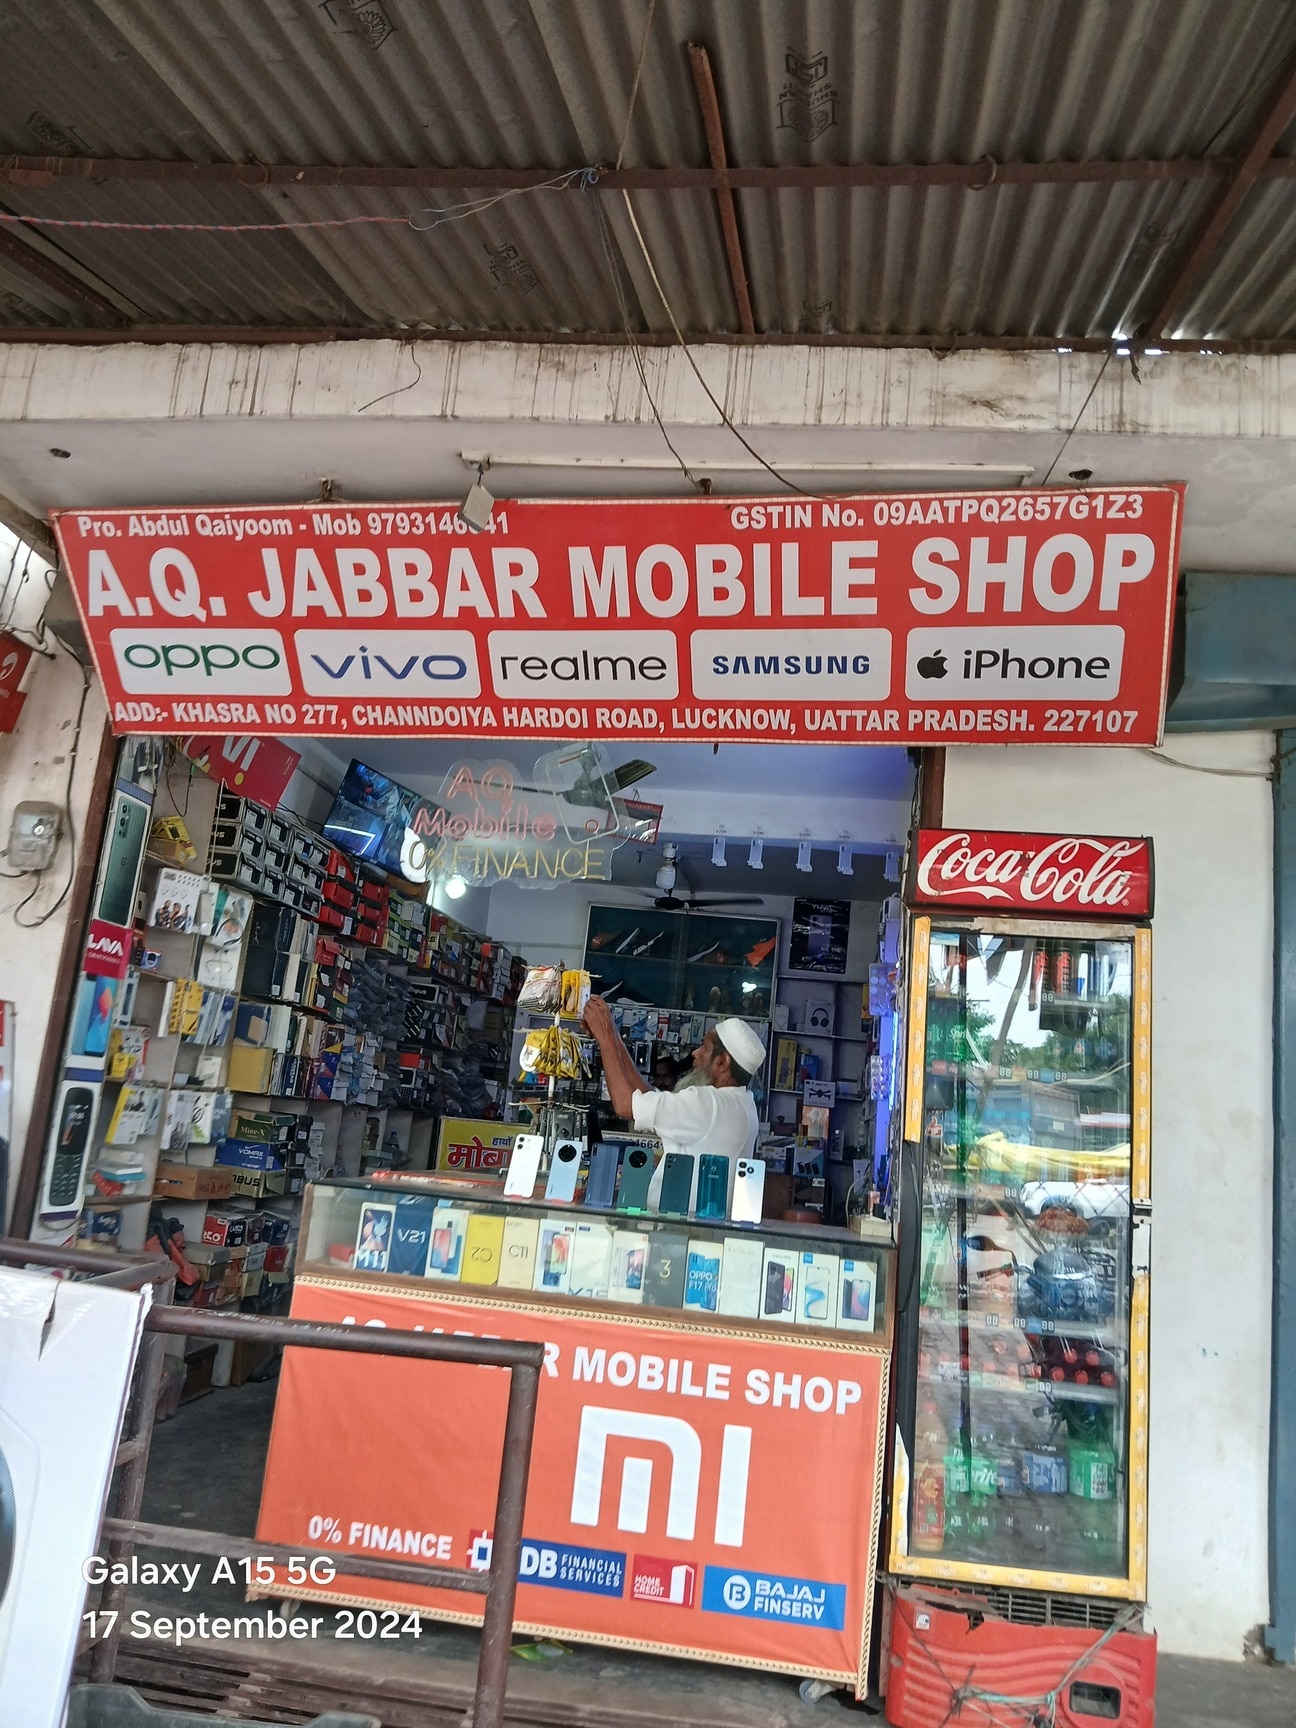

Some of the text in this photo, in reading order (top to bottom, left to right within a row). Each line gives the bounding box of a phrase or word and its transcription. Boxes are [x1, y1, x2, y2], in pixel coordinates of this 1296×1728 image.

[79, 516, 122, 537] Pro.
[129, 514, 189, 537] Abdul
[195, 514, 293, 542] Qaiyoom
[313, 513, 361, 535] Mob
[368, 511, 509, 536] 979314641
[731, 494, 1143, 530] GSTIN No. 09AATPQ2657G1Z3
[88, 533, 1156, 622] A.Q. JABBAR MOBILE SHOP
[123, 643, 281, 676] oppo
[311, 645, 468, 680] vivo
[501, 648, 667, 682] realme
[712, 655, 871, 675] SAMSUNG
[963, 648, 1110, 680] iPhone
[115, 703, 1138, 735] ADD:- KHASRA NO 277, CHANNDOIYA HARDOI ROAD, LUCKNOW, UATTAR PRADESH. 227107
[447, 766, 514, 812] AQ
[413, 804, 557, 841] Mobile
[451, 846, 605, 880] FINANCE
[917, 833, 1145, 905] Coca-Cola
[87, 934, 124, 957] LAVA
[397, 1228, 426, 1243] V21
[508, 1244, 529, 1259] C11
[659, 1259, 671, 1279] 3
[689, 1269, 713, 1281] OPPO
[688, 1280, 717, 1293] F17 Pro
[573, 1345, 730, 1400] MOBILE
[745, 1368, 862, 1415] SHOP
[308, 1515, 453, 1560] 0% FINANCE
[520, 1546, 623, 1579] DB FINANCIAL
[559, 1566, 621, 1588] SERVICES
[634, 1584, 664, 1597] CREDIT
[635, 1575, 661, 1587] HOME
[755, 1579, 826, 1604] BAJAJ
[754, 1600, 825, 1621] FINSERV
